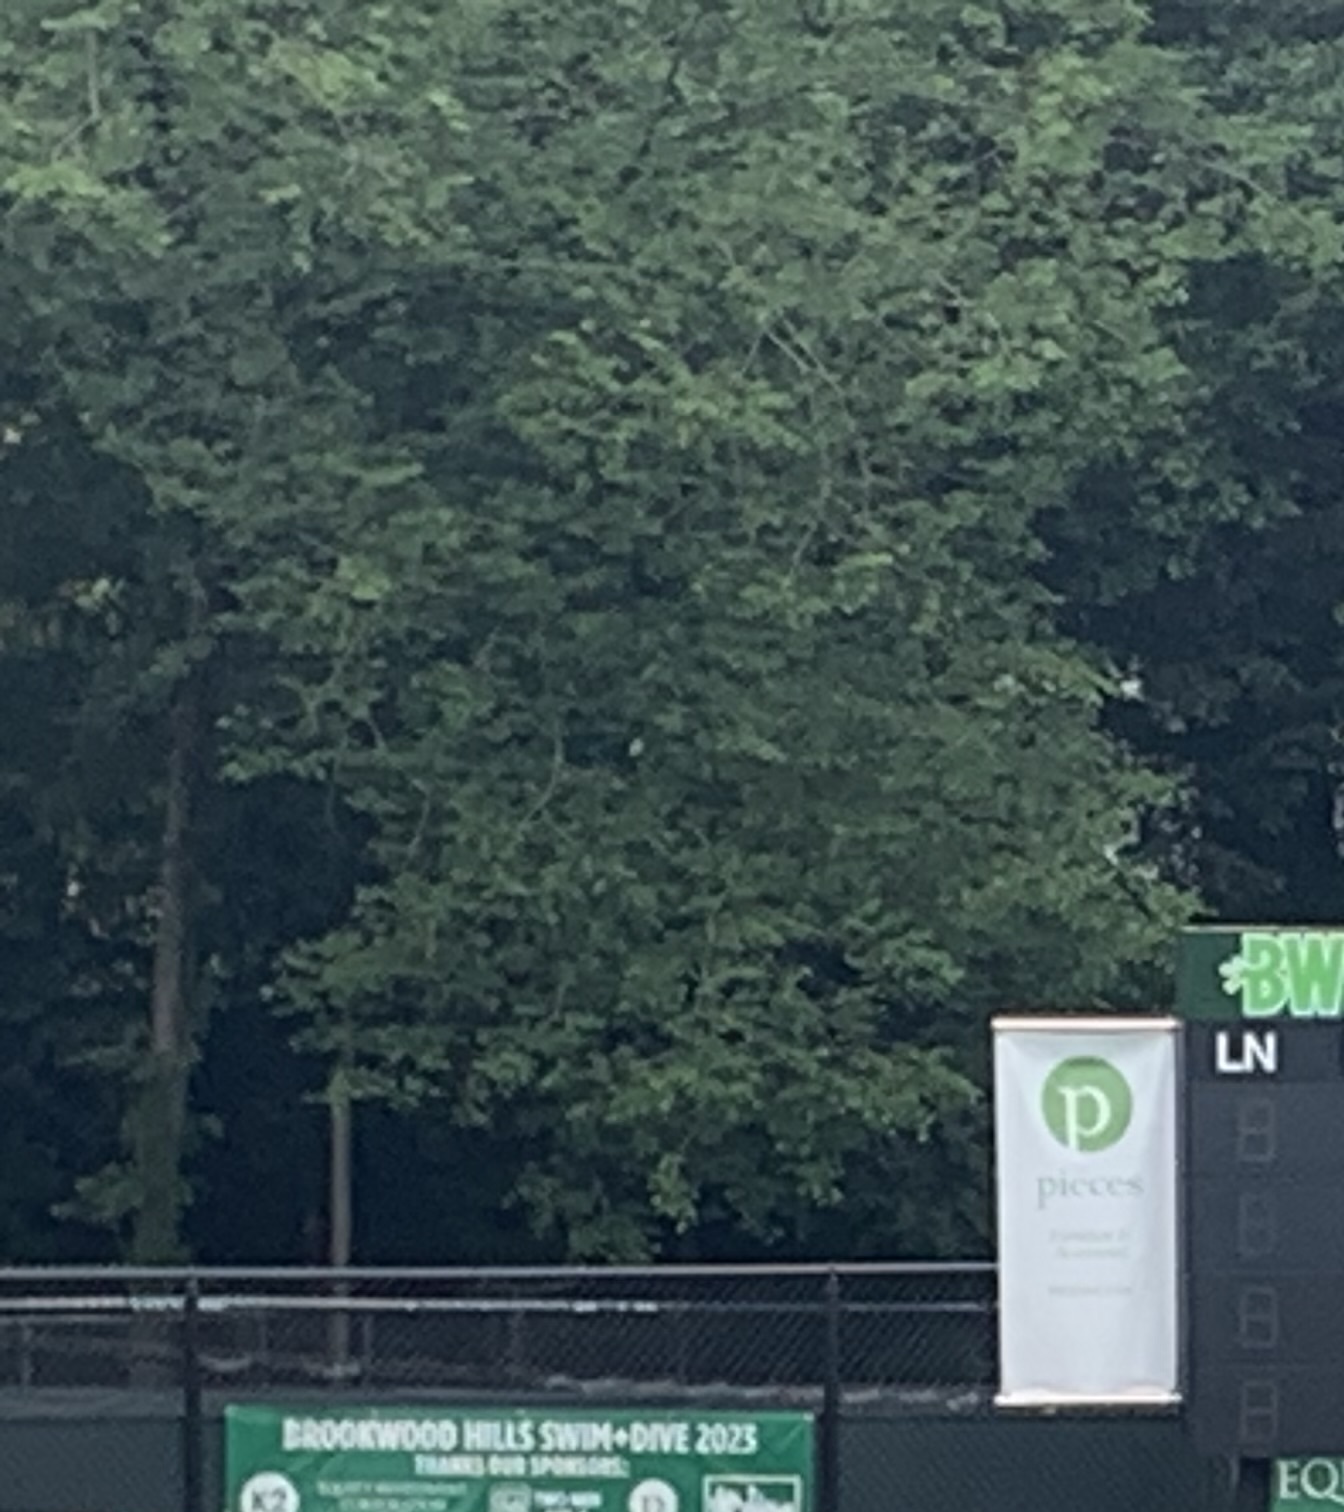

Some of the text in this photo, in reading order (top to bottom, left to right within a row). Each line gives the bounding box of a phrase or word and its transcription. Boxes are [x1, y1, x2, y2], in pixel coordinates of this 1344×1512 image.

[1216, 1032, 1277, 1072] LN
[1036, 1169, 1145, 1210] pieces
[282, 1418, 457, 1451] BROOKWOOD
[462, 1418, 535, 1452] HILLS
[694, 1422, 759, 1455] 2023
